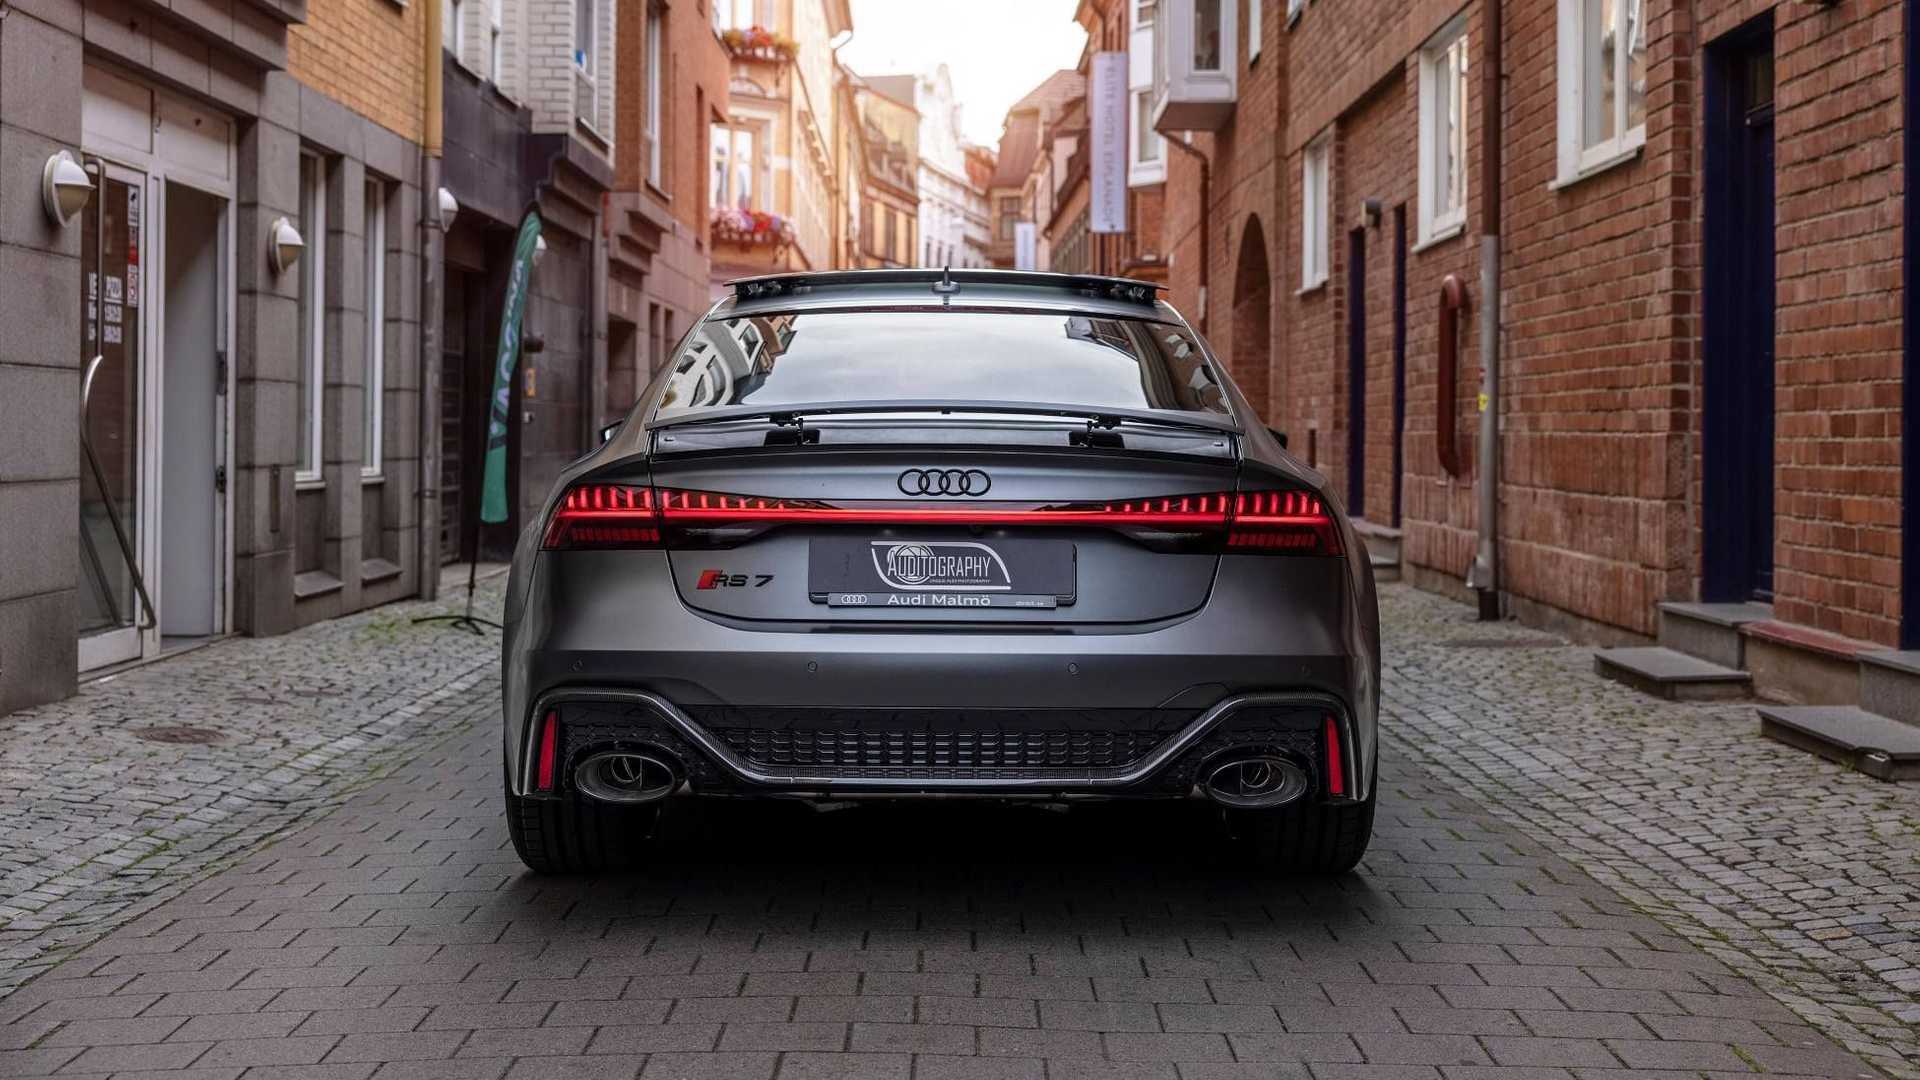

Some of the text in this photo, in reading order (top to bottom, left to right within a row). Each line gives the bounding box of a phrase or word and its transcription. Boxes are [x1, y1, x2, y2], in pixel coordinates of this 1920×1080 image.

[887, 551, 991, 577] AUDITOGRAPHY
[711, 573, 775, 589] RS 7
[887, 593, 991, 606] Audi Malmö
